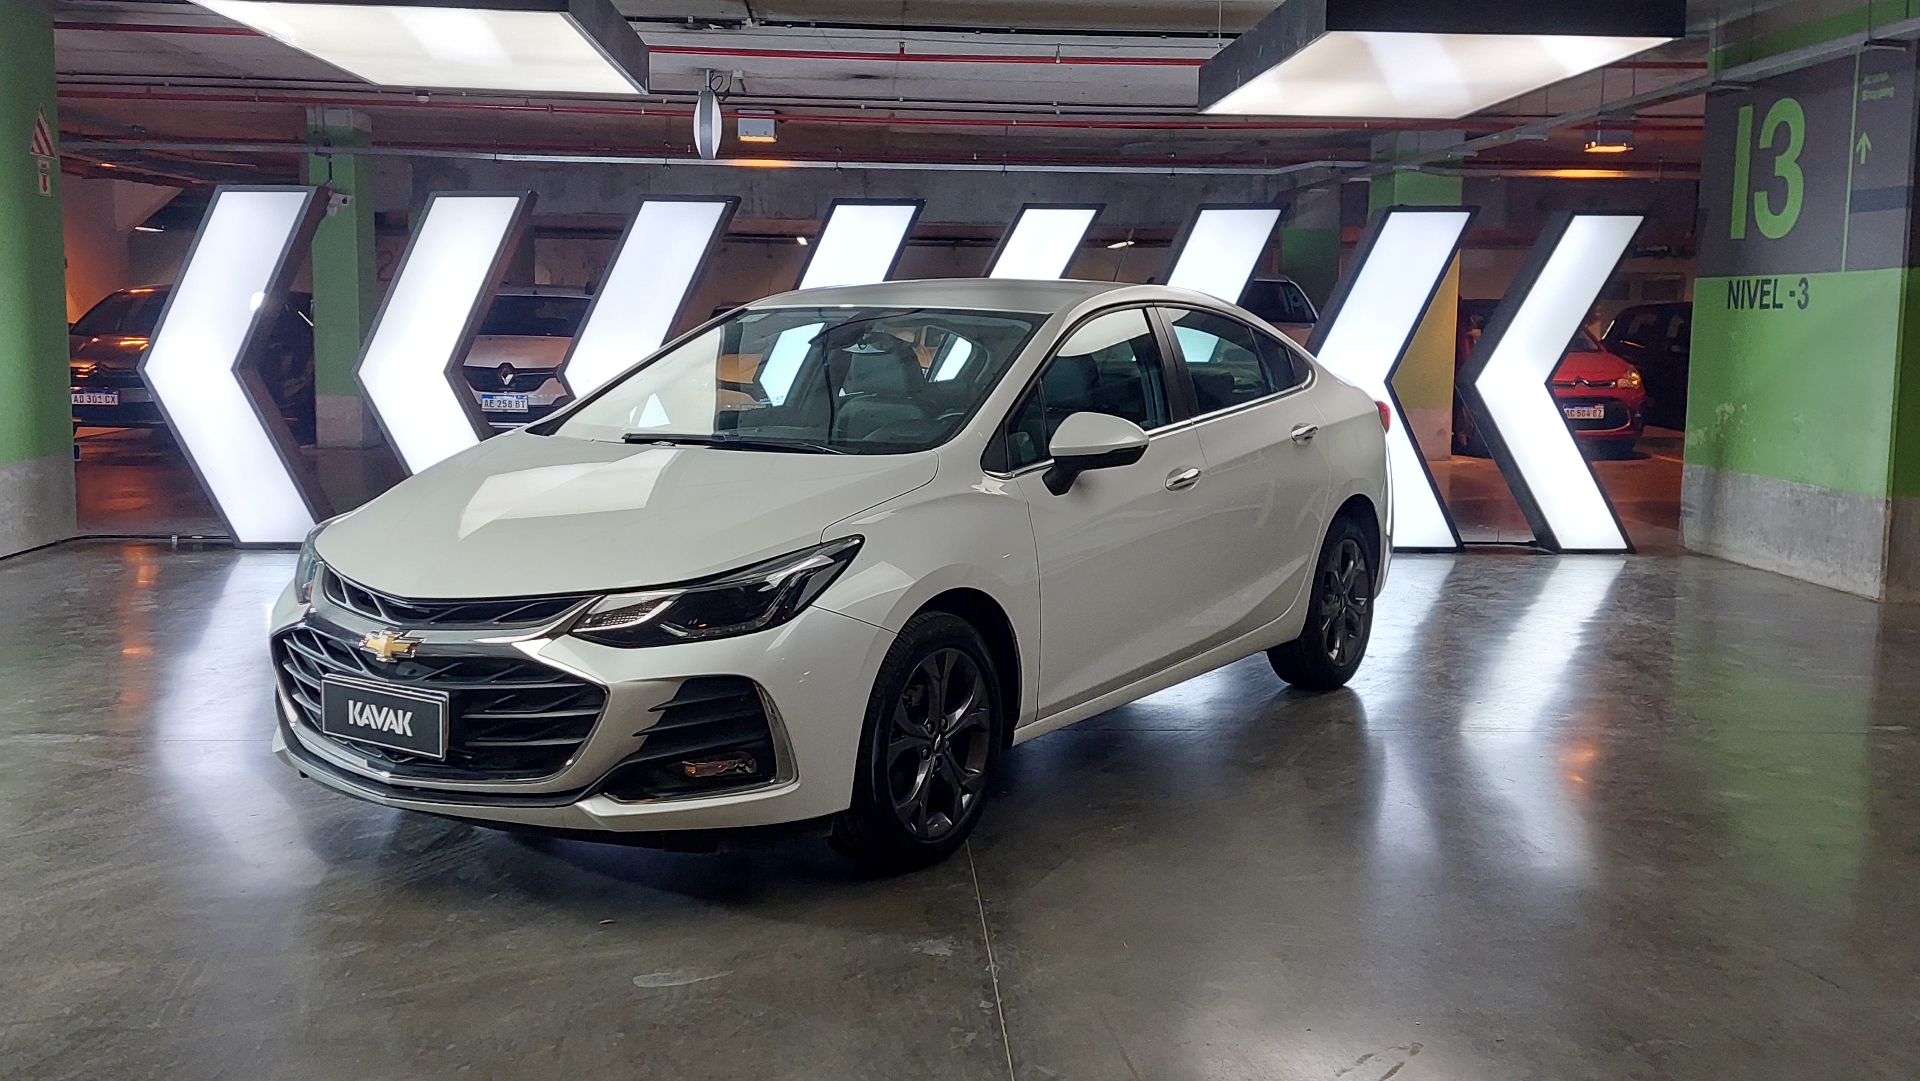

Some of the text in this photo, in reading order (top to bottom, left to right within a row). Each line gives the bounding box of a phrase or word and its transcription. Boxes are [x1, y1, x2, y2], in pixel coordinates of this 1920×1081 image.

[1730, 97, 1806, 240] 13
[1727, 277, 1810, 311] NIVEL -3
[73, 395, 116, 404] AD 301 CX
[484, 399, 526, 408] AE 258 BT
[348, 699, 413, 737] KAVAK
